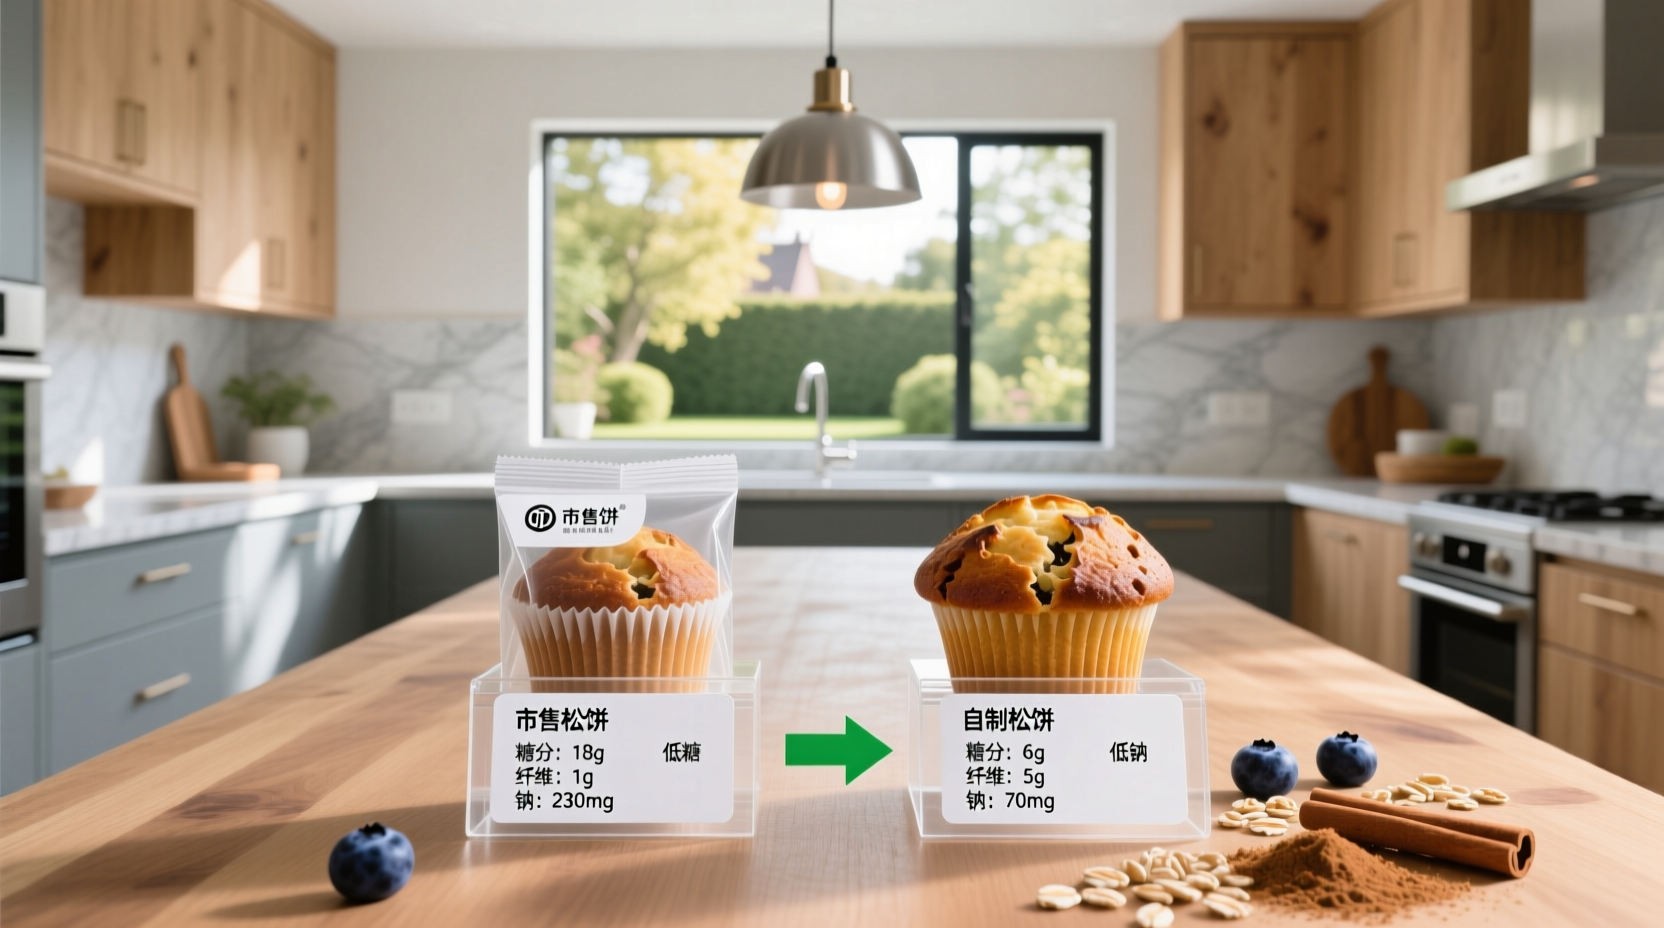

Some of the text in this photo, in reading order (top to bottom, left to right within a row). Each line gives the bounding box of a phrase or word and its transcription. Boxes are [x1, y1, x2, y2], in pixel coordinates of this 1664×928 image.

[562, 507, 619, 526] 市售饼
[515, 706, 609, 733] 市售松饼
[964, 706, 1055, 733] 自制松饼
[662, 741, 702, 763] 低糖
[1109, 741, 1148, 763] 低钠
